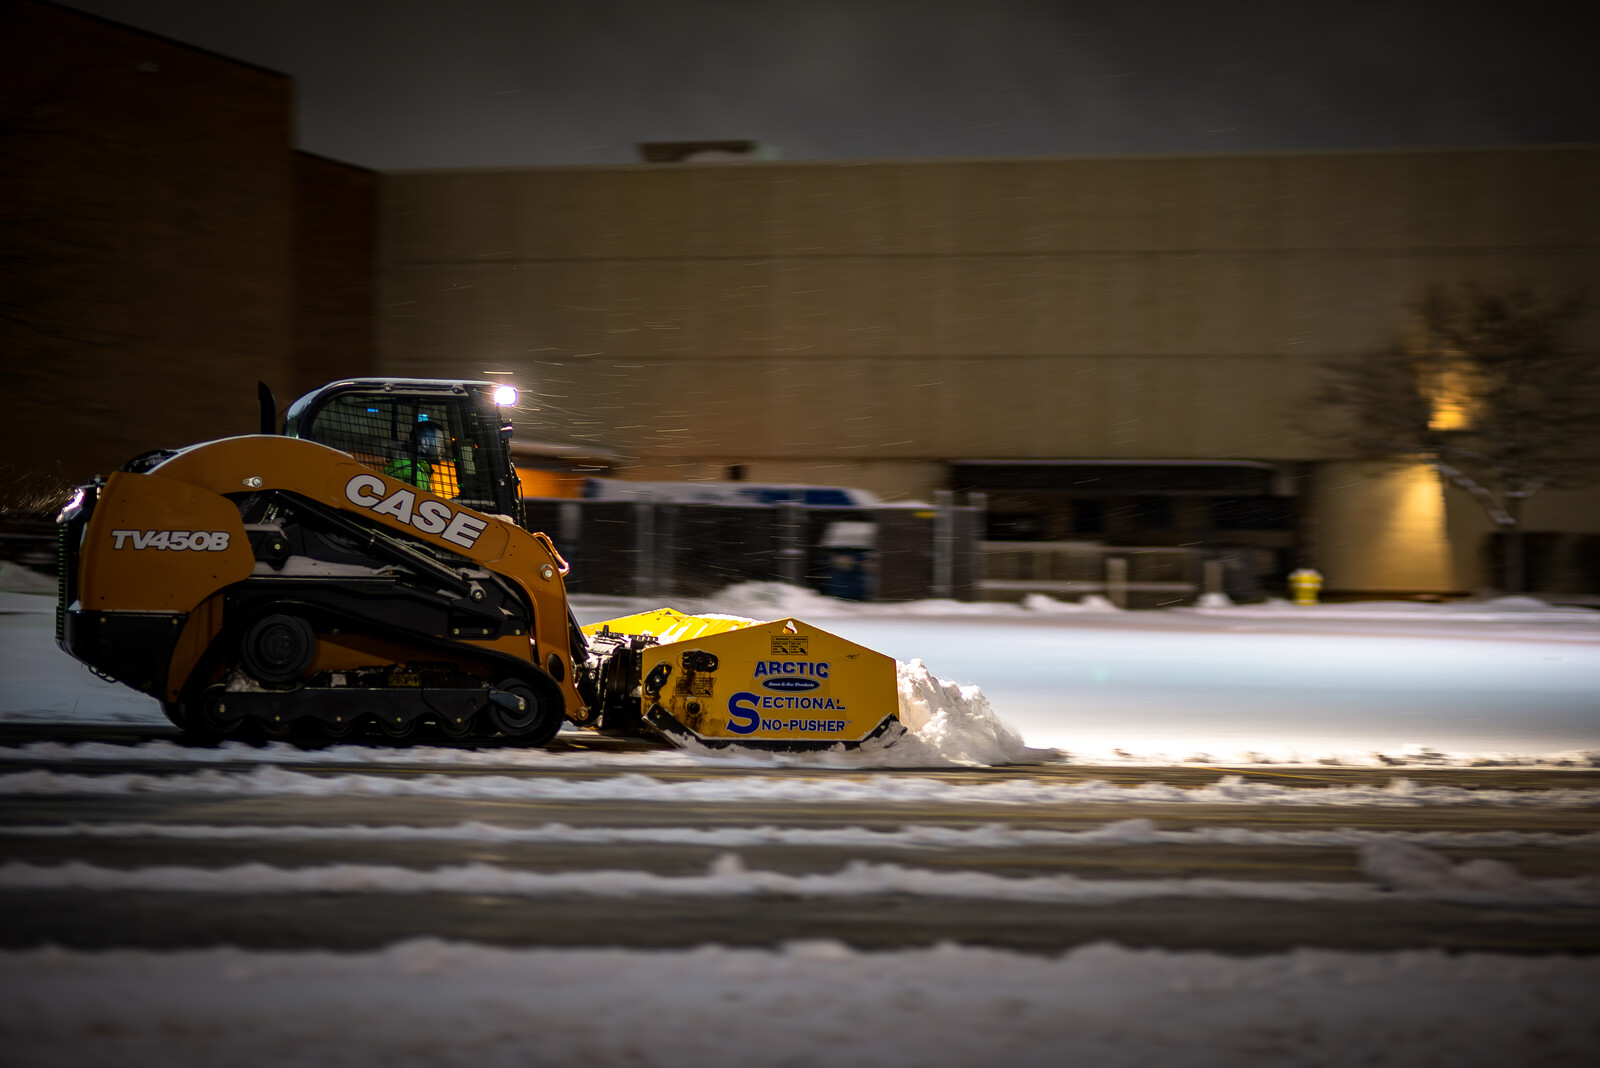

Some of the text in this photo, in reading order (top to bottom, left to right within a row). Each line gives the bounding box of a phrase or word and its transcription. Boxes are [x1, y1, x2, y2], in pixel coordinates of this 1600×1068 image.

[344, 473, 488, 550] CASE
[111, 529, 231, 552] TV450B
[754, 661, 830, 679] ARCTIC
